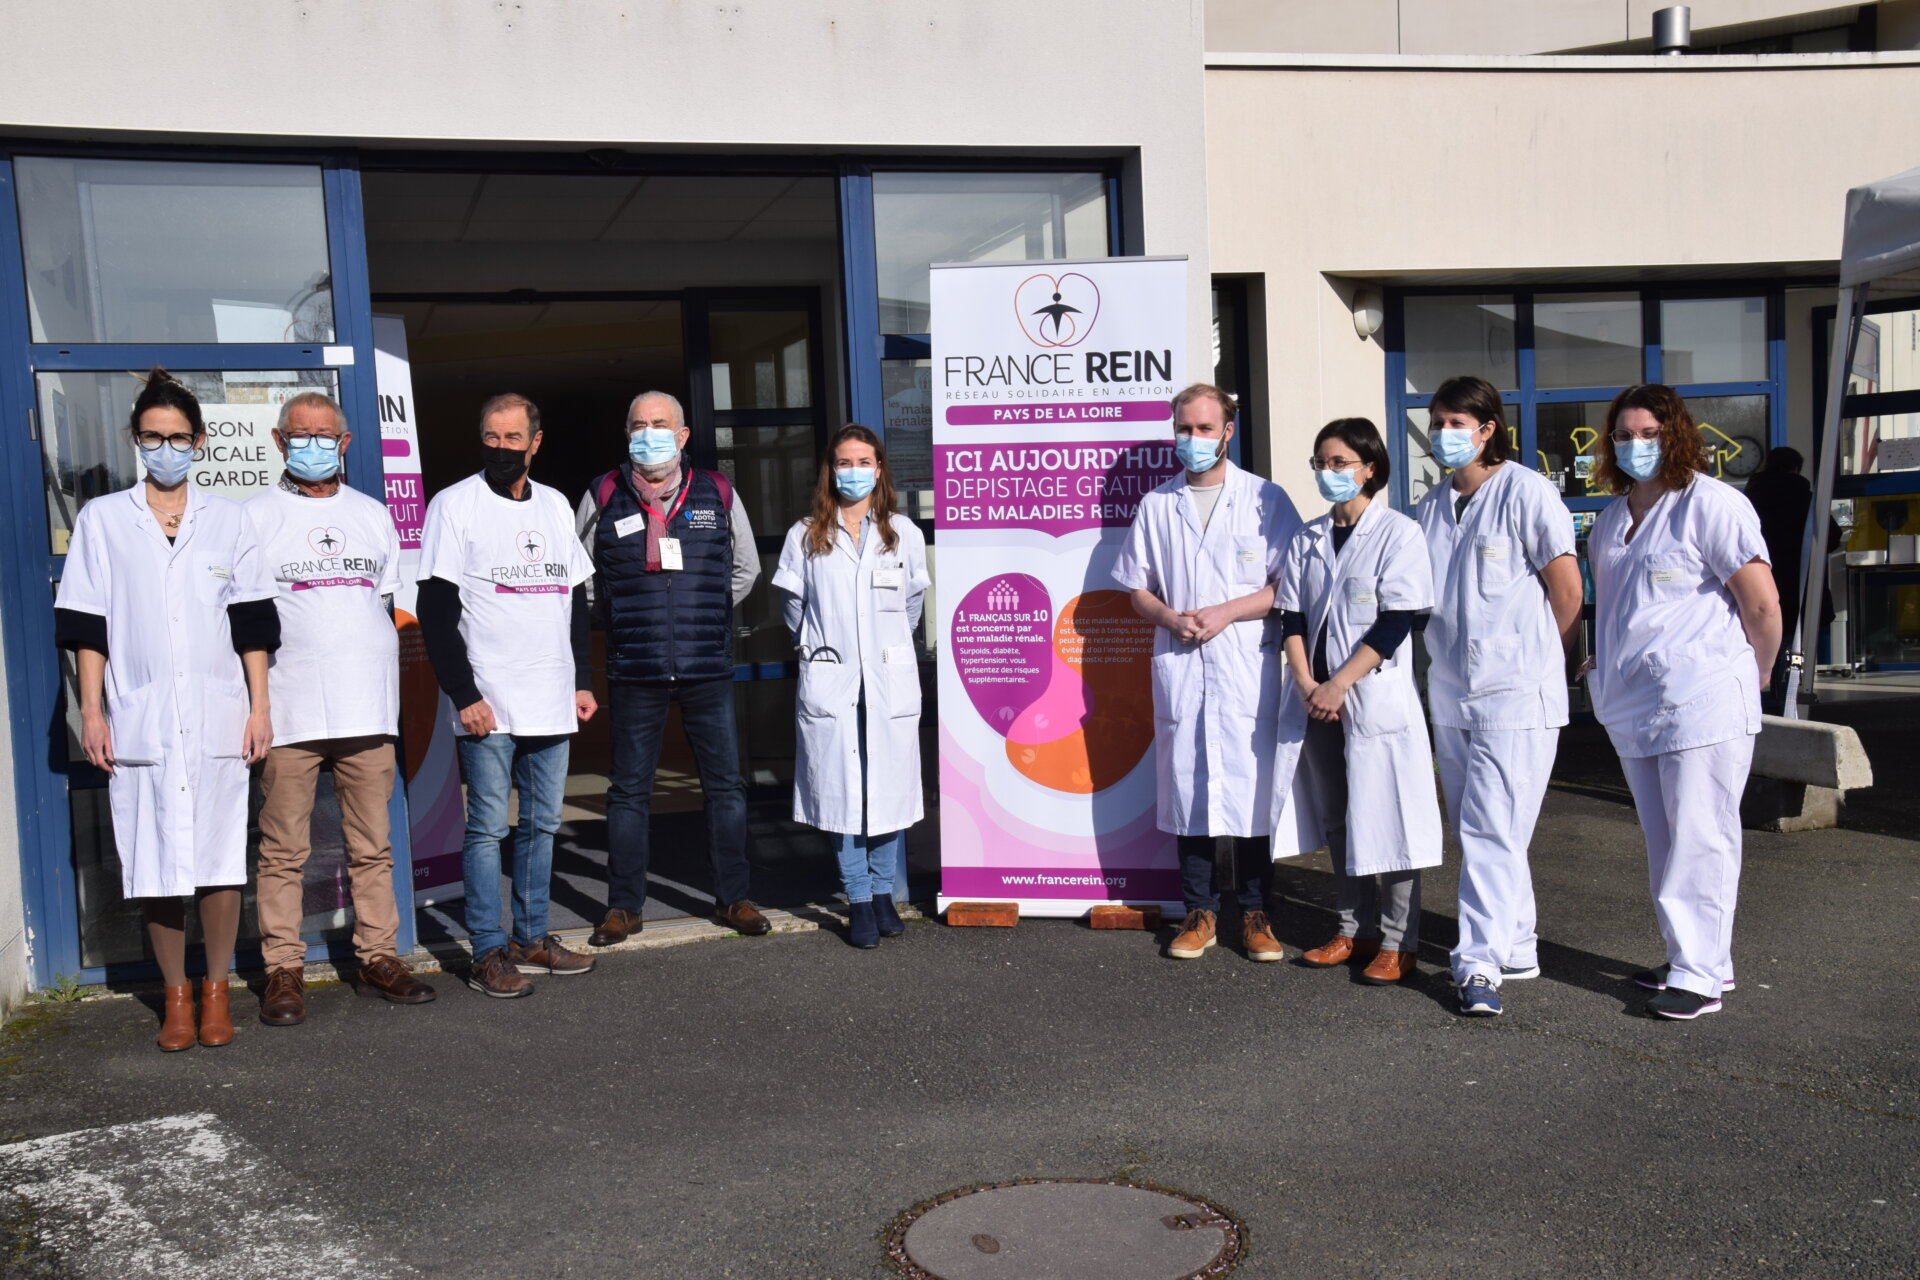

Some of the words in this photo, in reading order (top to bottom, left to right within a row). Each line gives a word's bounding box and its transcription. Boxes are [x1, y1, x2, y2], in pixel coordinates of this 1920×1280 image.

[945, 354, 1073, 386] FRANCE
[1085, 349, 1172, 383] REIN
[946, 389, 999, 400] RÉSEAU
[1008, 388, 1084, 398] SOLIDAIRE
[1093, 388, 1109, 396] EN
[1118, 386, 1174, 396] ACTION
[379, 394, 407, 423] IN
[901, 404, 931, 415] mala
[994, 408, 1030, 420] PAYS
[1035, 408, 1053, 419] DE
[1058, 407, 1077, 419] LA
[1081, 406, 1122, 418] LOIRE
[192, 446, 267, 462] DICALE
[946, 451, 982, 473] ICI
[990, 447, 1174, 472] AUJOURD'HUI
[196, 470, 269, 486] GARDE
[384, 480, 417, 498] HUI
[945, 477, 1068, 499] DEPISTAGE
[946, 506, 982, 521] DES
[988, 504, 1084, 520] MALADIES
[1091, 504, 1139, 519] RENA
[281, 557, 341, 579] FRANCE
[343, 558, 377, 573] REIN
[491, 564, 543, 582] FRANCE
[545, 563, 568, 578] REIN
[958, 610, 966, 622] 1
[969, 613, 1012, 623] FRANÇAIS
[1014, 613, 1031, 622] SUR
[1033, 609, 1048, 621] 10
[972, 624, 1014, 632] concerné
[1017, 625, 1032, 634] par
[977, 634, 1013, 642] maladie
[1015, 634, 1046, 642] rénale.
[1059, 637, 1075, 645] peut
[959, 647, 991, 655] Surpoids,
[1002, 874, 1126, 888] www.francerein.org
